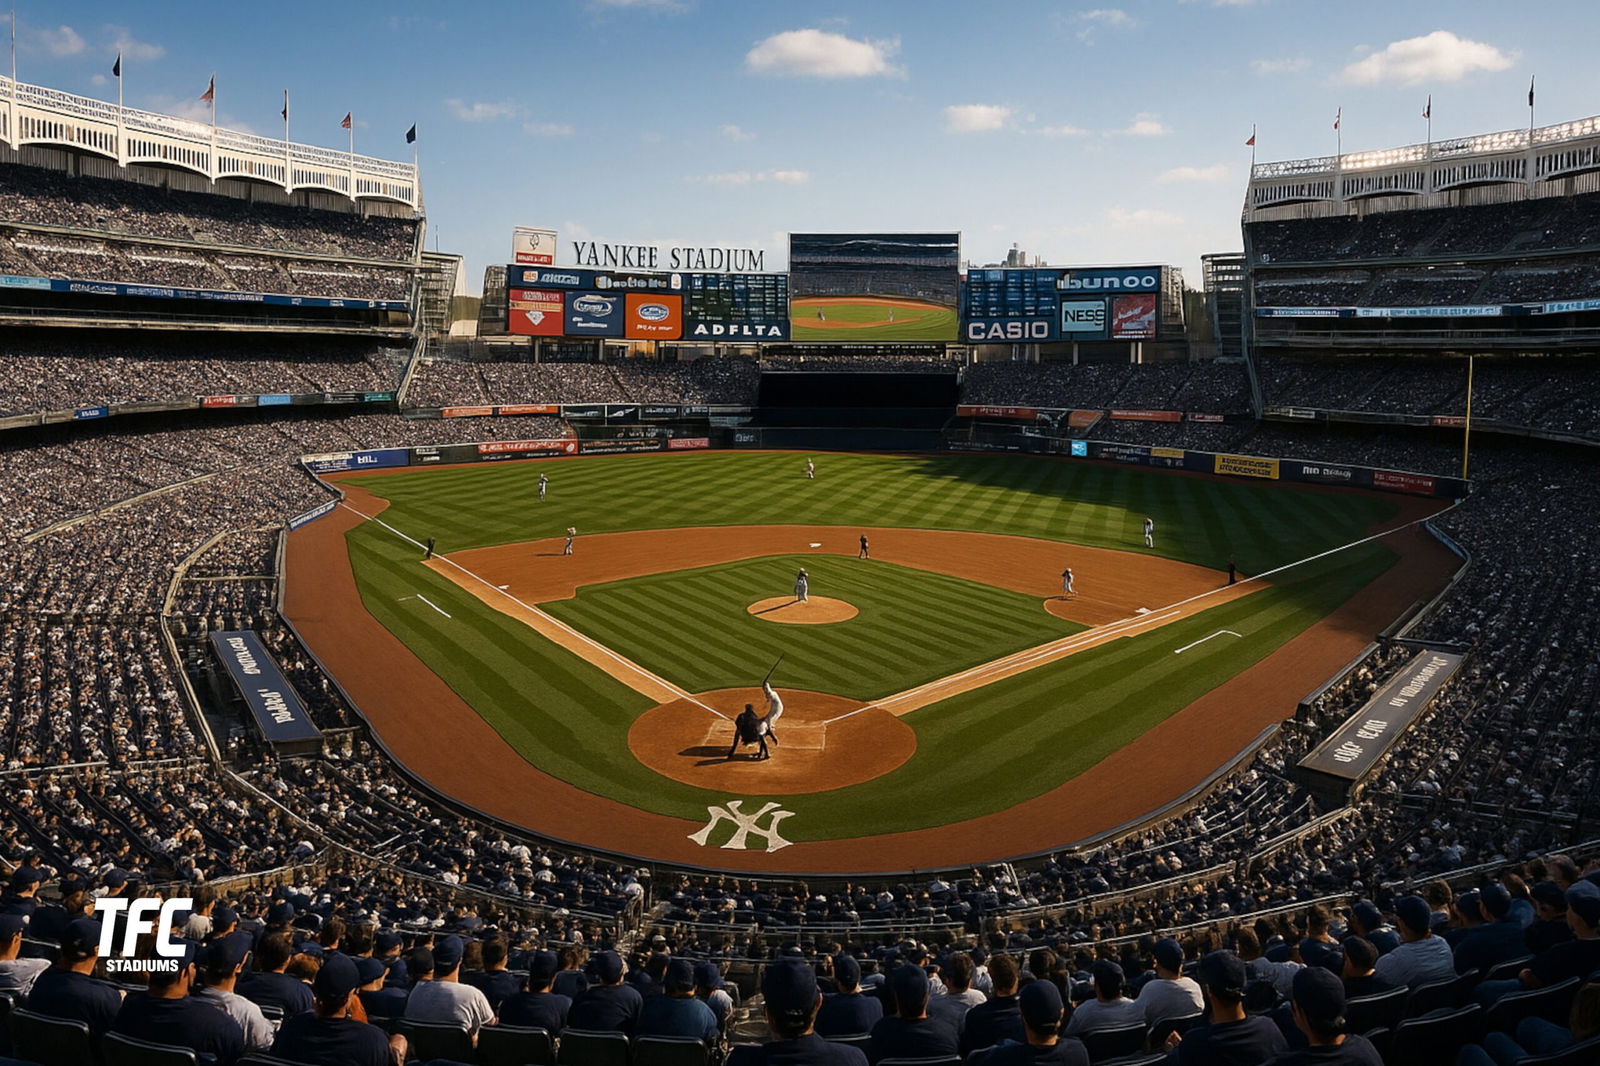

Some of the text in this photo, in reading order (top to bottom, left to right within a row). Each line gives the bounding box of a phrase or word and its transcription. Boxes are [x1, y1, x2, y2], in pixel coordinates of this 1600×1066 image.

[573, 241, 765, 272] YANKEE STADIUM
[968, 321, 1049, 340] CASIO
